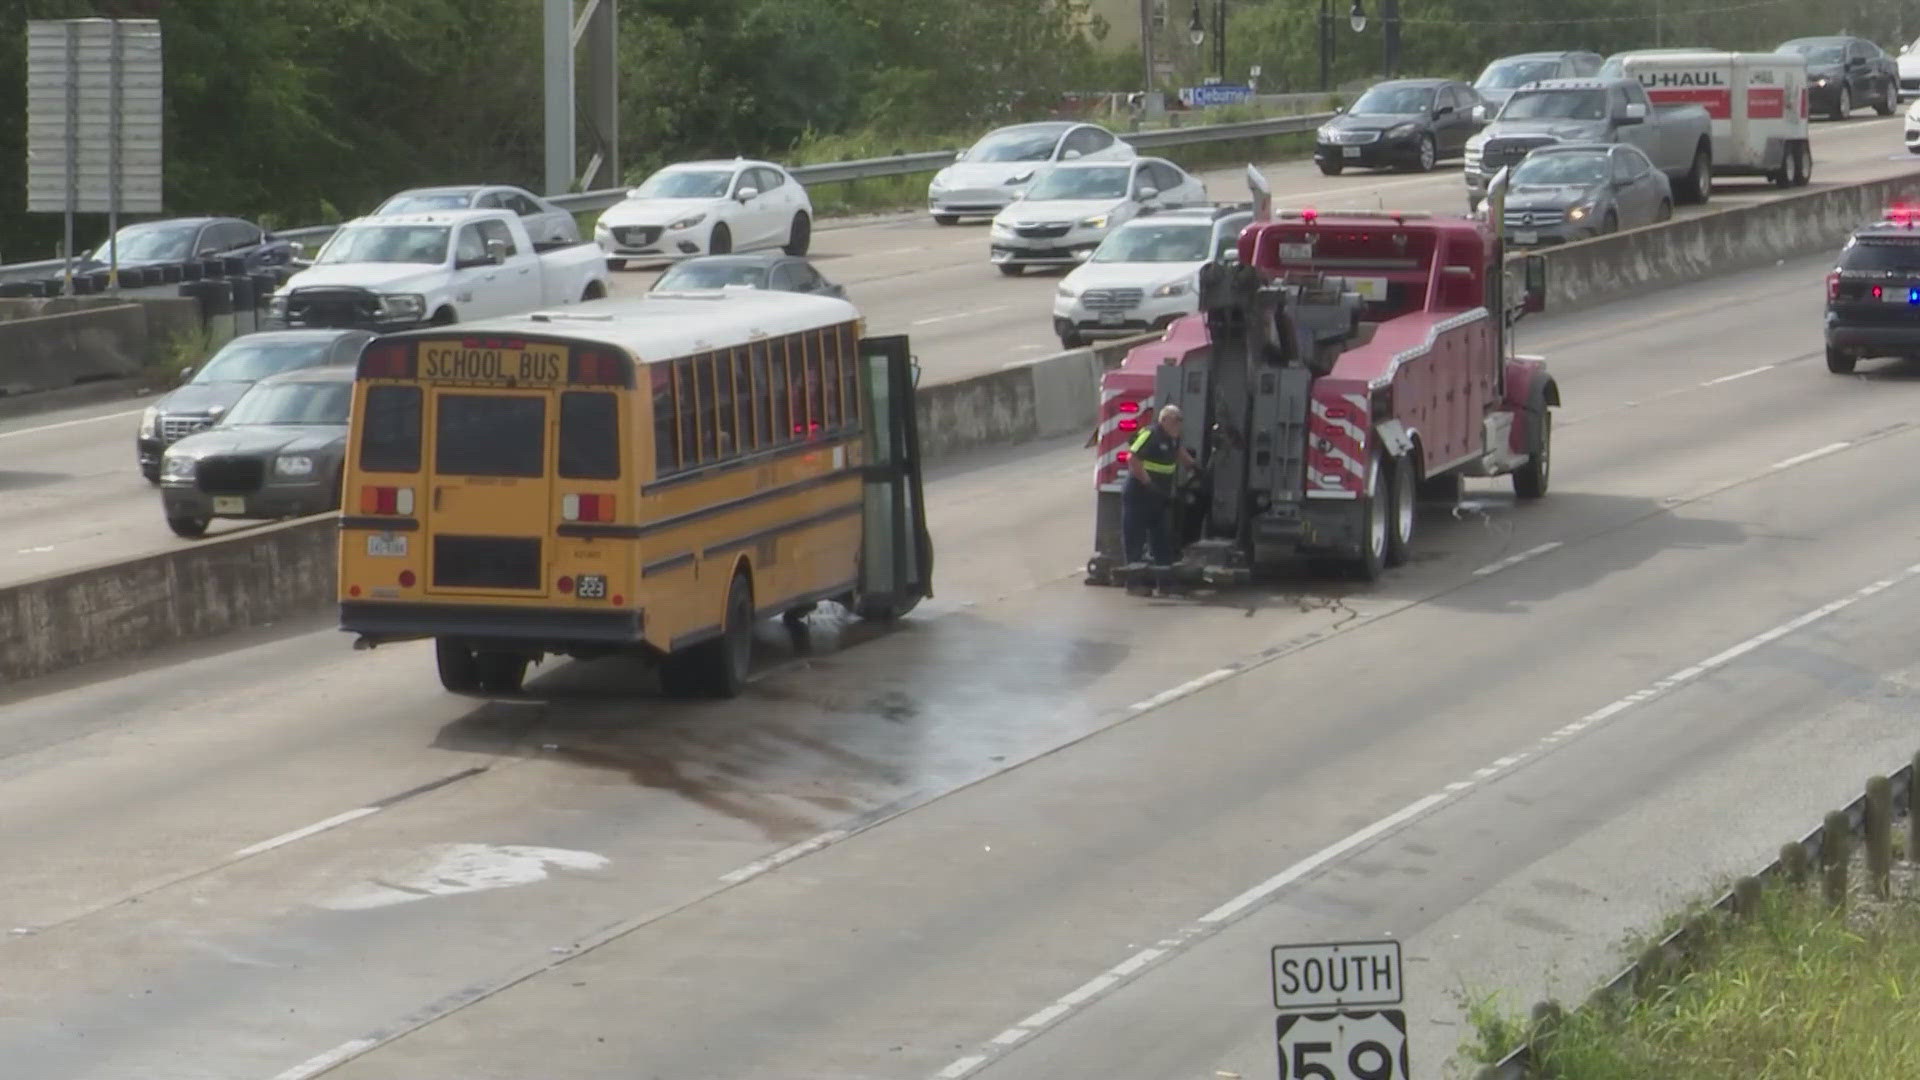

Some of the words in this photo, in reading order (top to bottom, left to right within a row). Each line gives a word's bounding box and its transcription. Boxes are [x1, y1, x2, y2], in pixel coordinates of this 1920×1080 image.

[1638, 72, 1724, 87] U-HAUL
[426, 350, 506, 378] SCHOOL
[520, 352, 560, 380] BUS
[1281, 955, 1391, 994] SOUTH
[1293, 1040, 1392, 1080] 59
